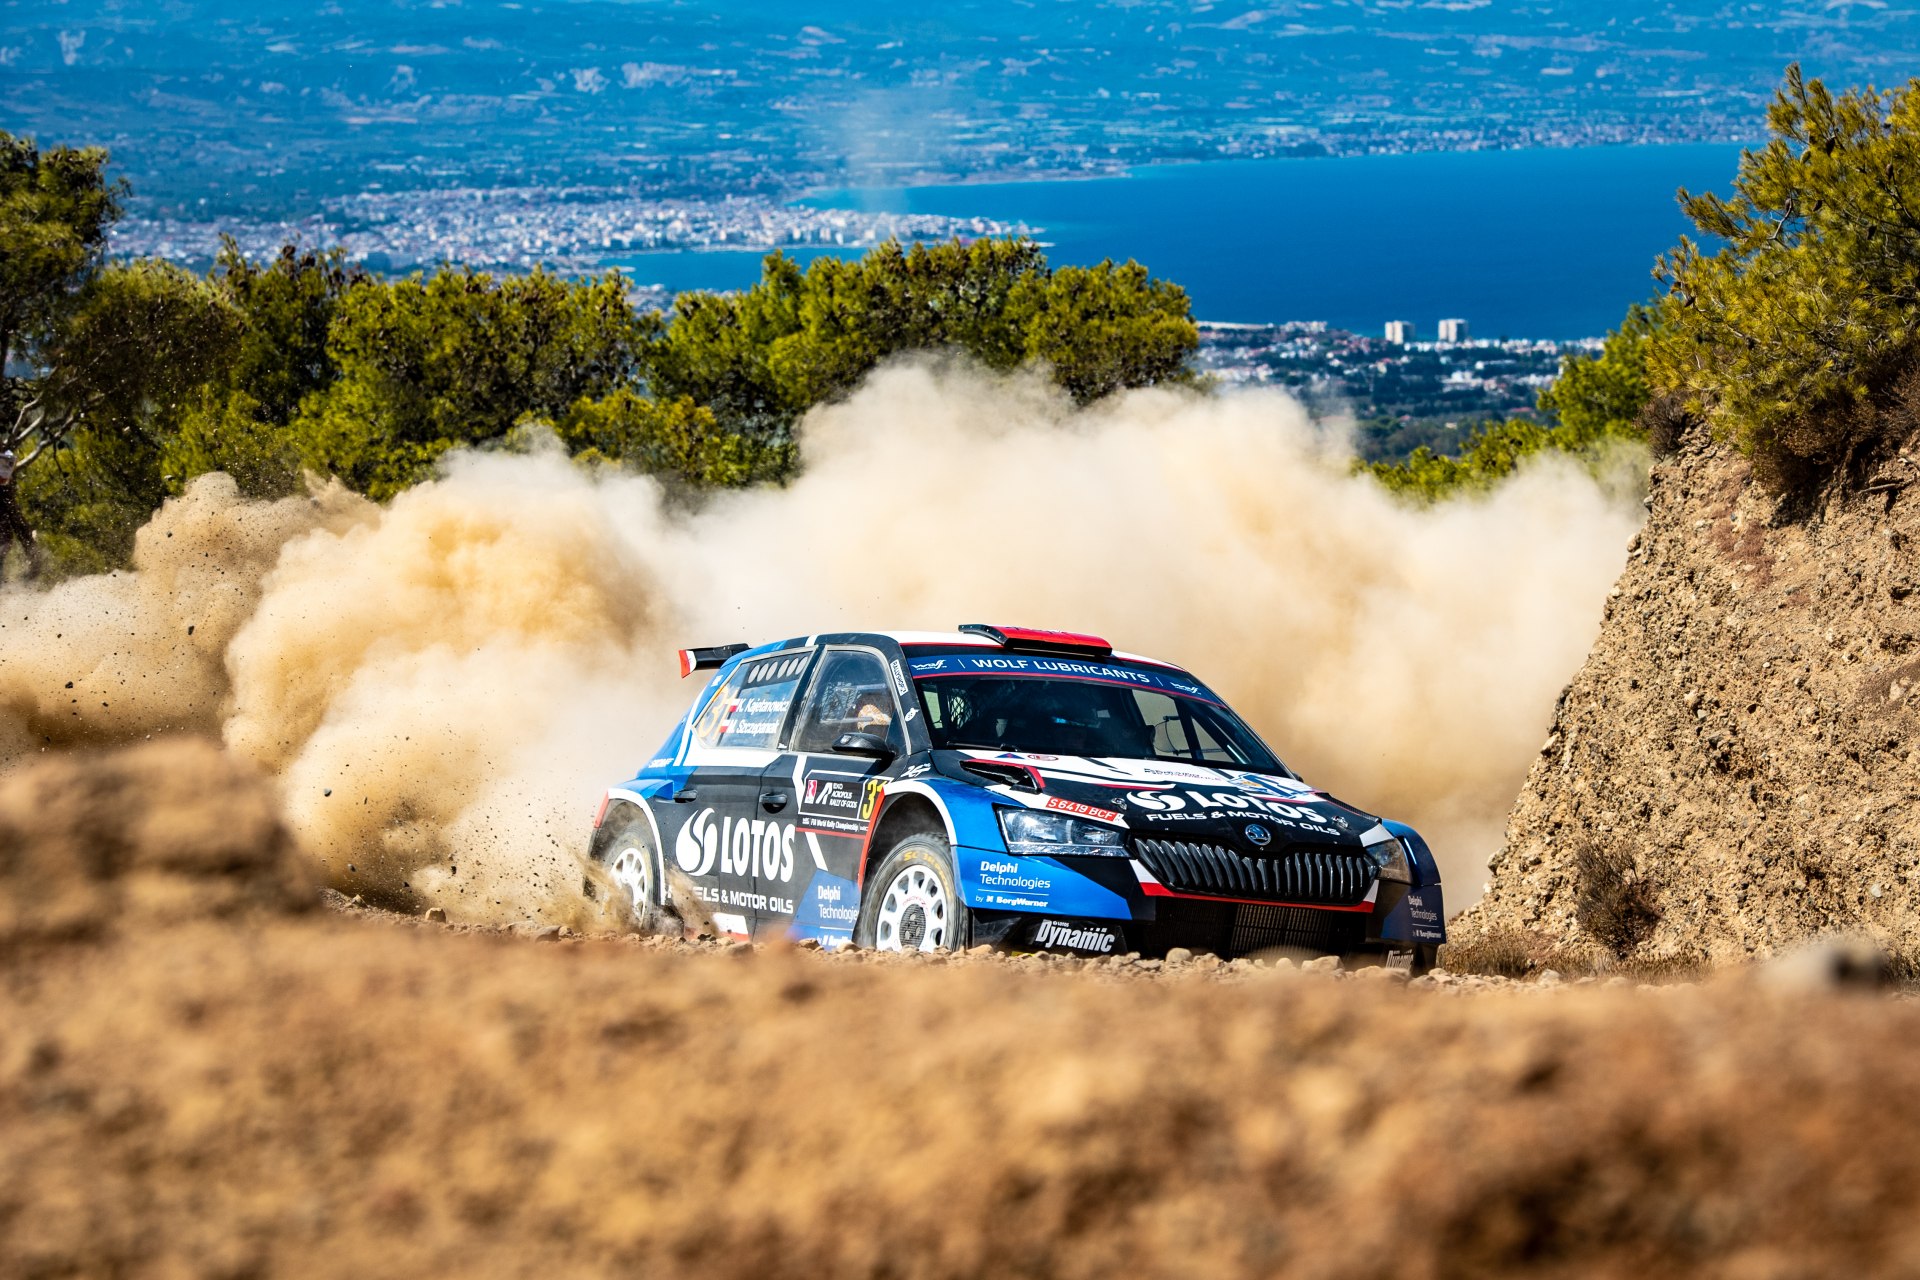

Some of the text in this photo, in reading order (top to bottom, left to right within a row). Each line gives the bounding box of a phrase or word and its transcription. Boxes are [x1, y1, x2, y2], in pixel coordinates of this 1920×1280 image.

[971, 659, 1150, 683] WOLF LUBRICANTS
[829, 799, 840, 807] RALLY
[846, 800, 858, 808] GODS
[831, 790, 852, 799] ACROPOLIS
[1048, 799, 1116, 819] S 6419 BCF
[1185, 791, 1328, 823] LOTOS
[1146, 811, 1341, 836] FUELS & MOTOR OILS
[721, 816, 796, 883] LOTOS
[980, 861, 1018, 874] Delphi
[980, 874, 1051, 889] Technologies
[722, 890, 729, 903] &
[729, 890, 767, 911] MOTOR
[769, 896, 794, 915] OILS
[818, 885, 841, 903] Delphi
[996, 895, 1048, 908] BorgWarner
[818, 904, 859, 923] Technologie
[1035, 919, 1115, 952] Dynamic
